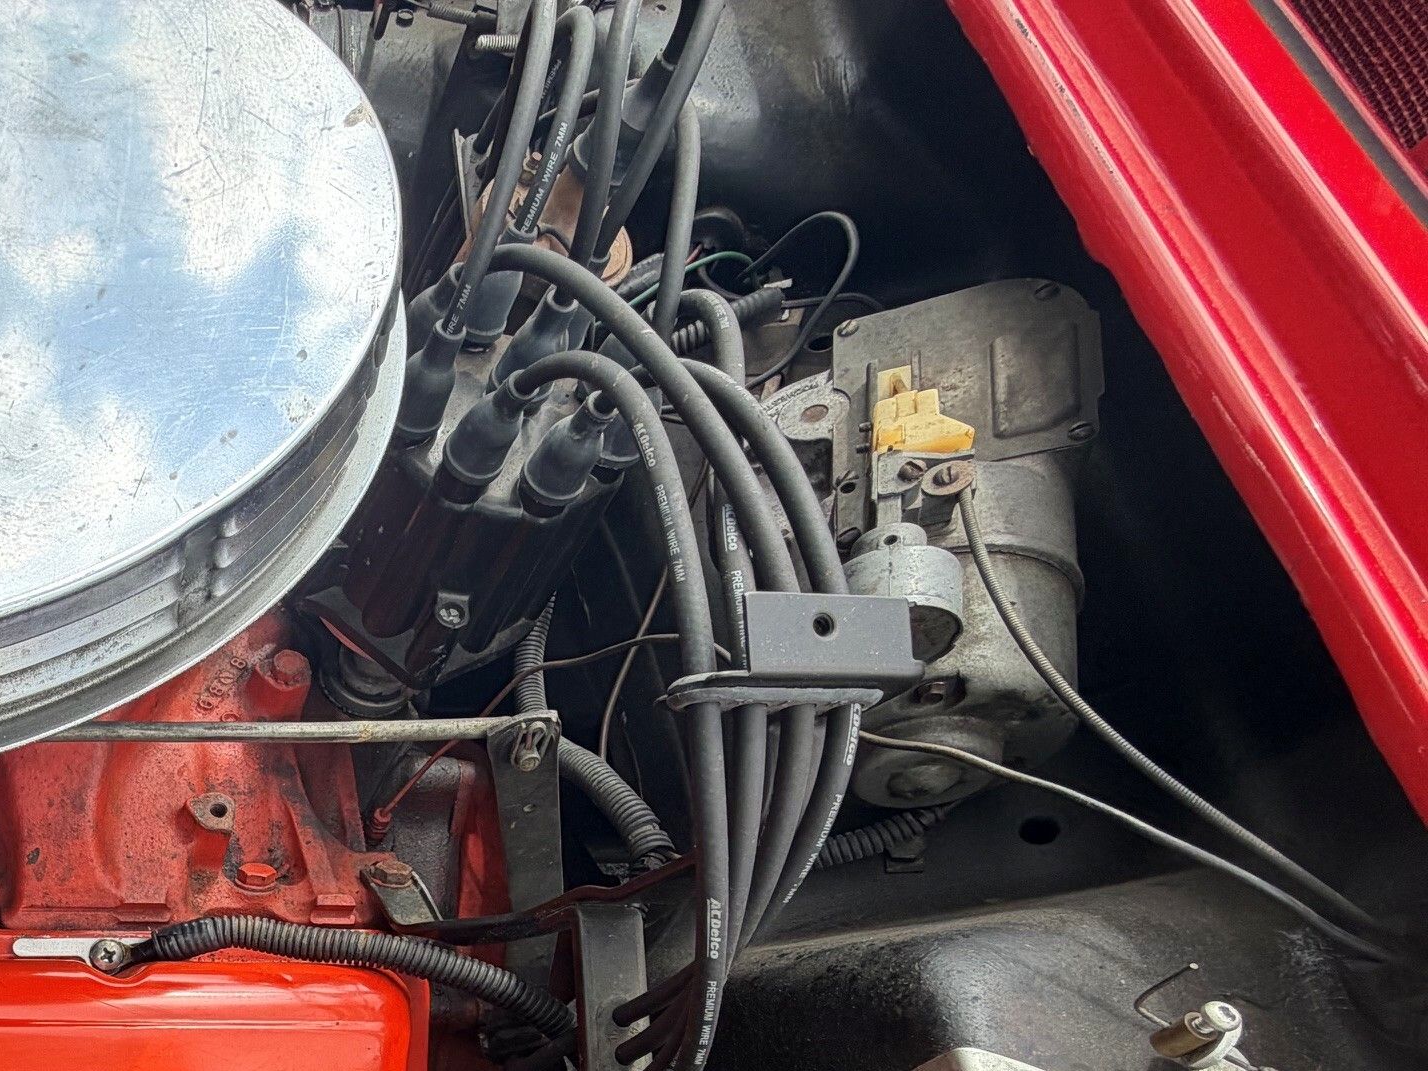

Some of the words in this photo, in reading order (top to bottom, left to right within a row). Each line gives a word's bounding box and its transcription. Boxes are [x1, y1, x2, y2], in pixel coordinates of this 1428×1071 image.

[522, 188, 545, 233] REMIUM
[542, 151, 559, 183] WIRE
[554, 121, 568, 149] 7MM
[445, 313, 460, 336] IRE
[456, 283, 472, 310] 7MM
[633, 422, 657, 470] ACDelco
[654, 483, 674, 528] PREMIUM
[723, 503, 739, 552] ACDelco
[666, 527, 681, 557] WIRE
[673, 557, 687, 583] 7MM
[730, 569, 745, 616] PREMIUM
[845, 702, 862, 768] CDelco
[815, 793, 843, 848] PREMIUM
[798, 851, 819, 880] WIRE
[707, 896, 723, 960] ACDelco
[703, 980, 718, 1022] PREMIUM
[694, 1047, 707, 1066] 7MM
[698, 1023, 712, 1046] WIRE
